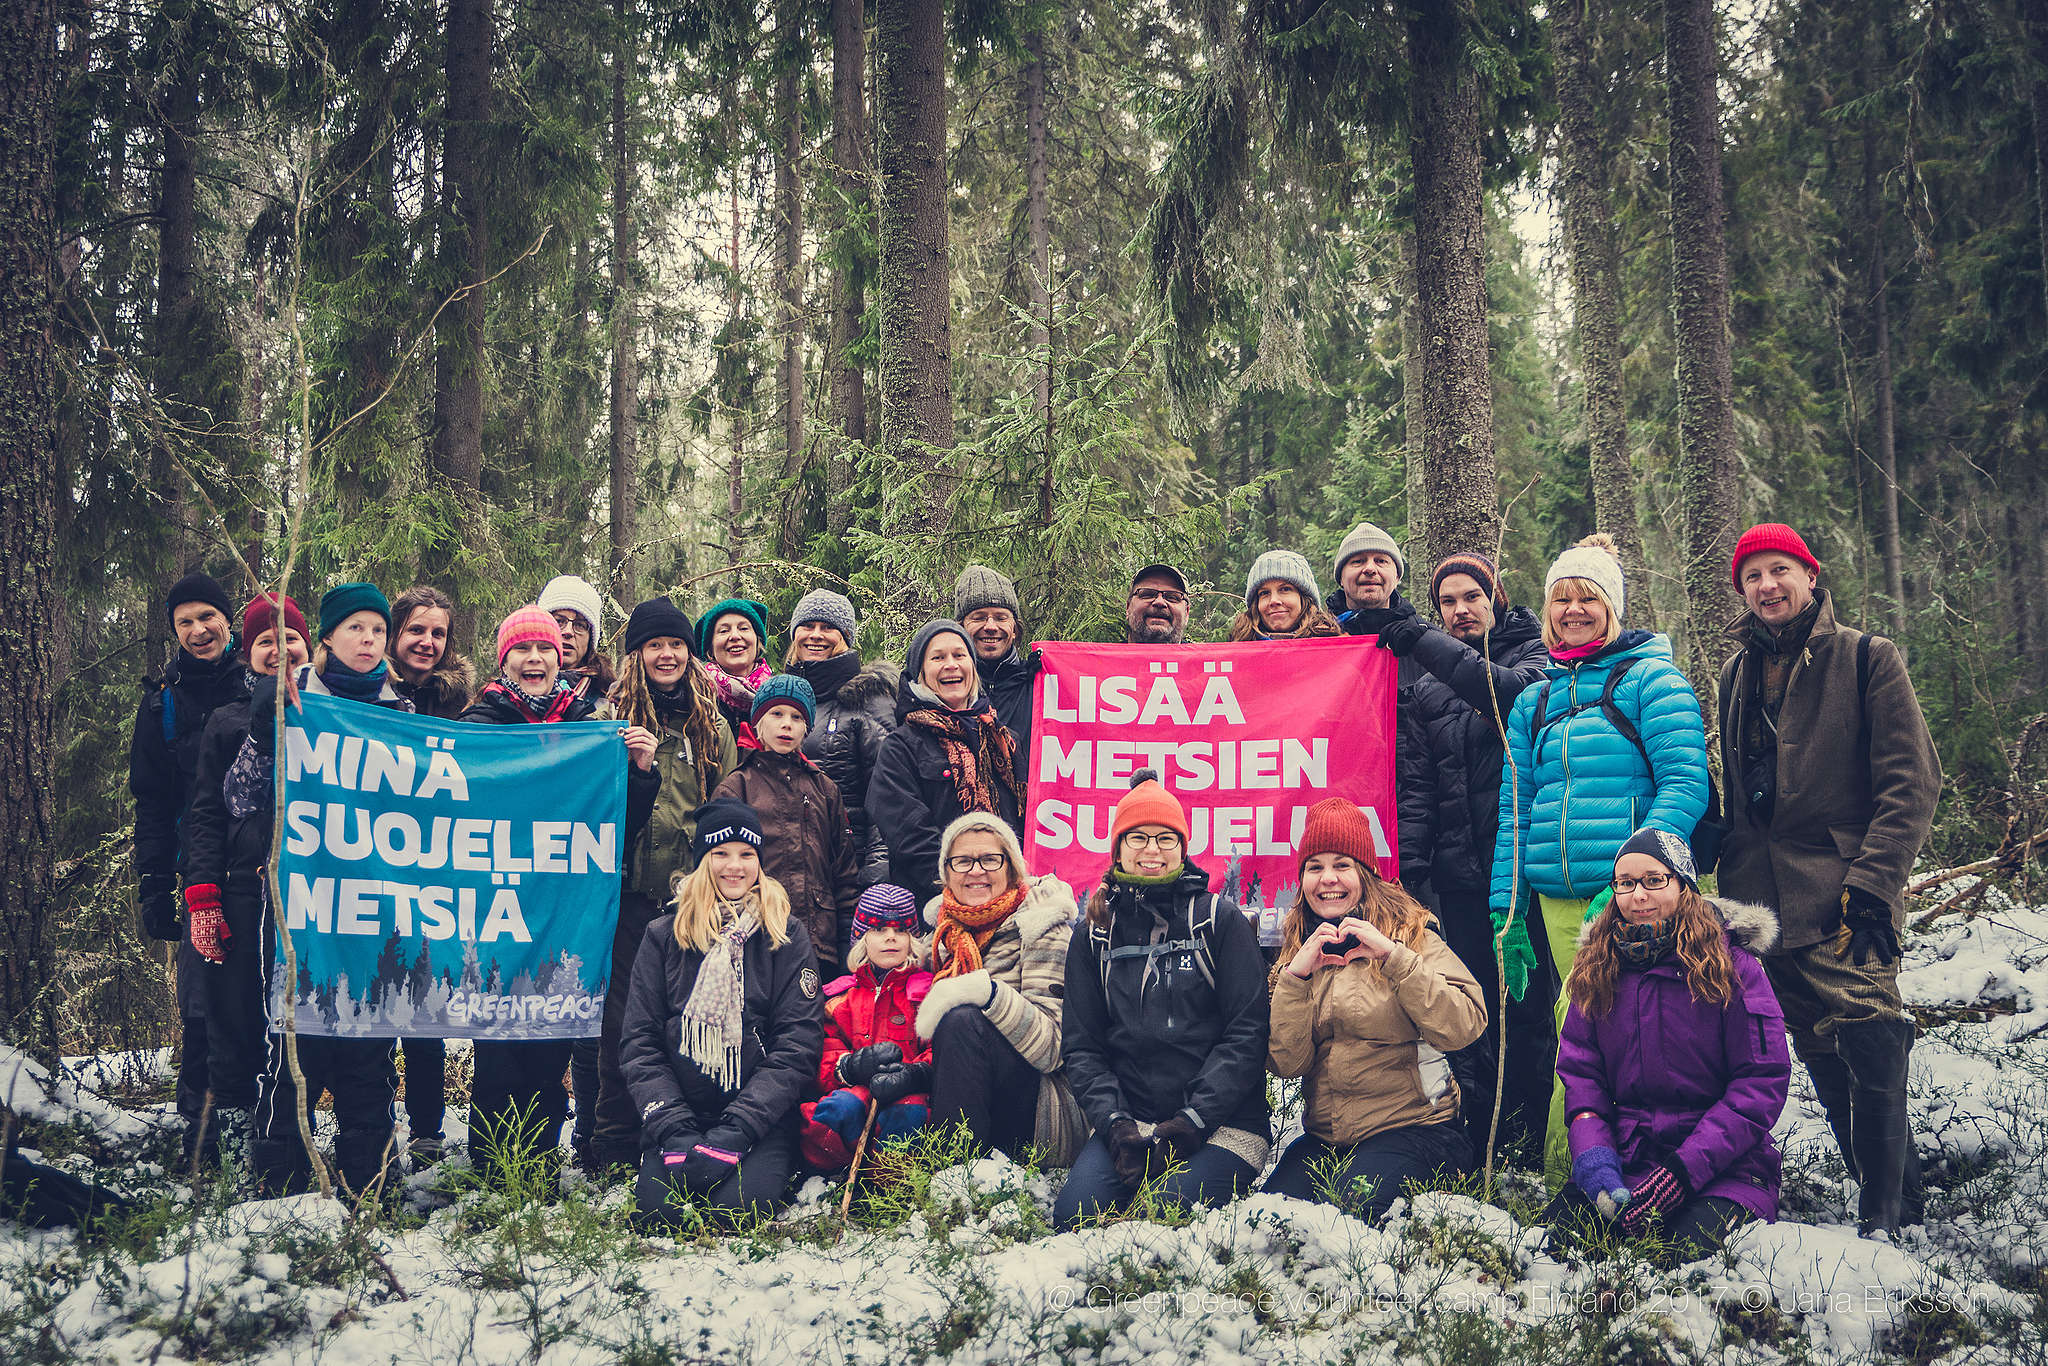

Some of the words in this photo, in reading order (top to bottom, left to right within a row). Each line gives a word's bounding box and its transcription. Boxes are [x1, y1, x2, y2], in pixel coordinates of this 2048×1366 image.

[1043, 661, 1246, 725] LISÄÄ
[284, 726, 470, 801] MINÄ
[1040, 735, 1329, 791] METSIEN
[286, 801, 616, 874] SUOJELEN
[1034, 799, 1392, 858] SUJEL
[287, 873, 533, 943] METSIÄ
[446, 992, 604, 1023] GREENPEACE
